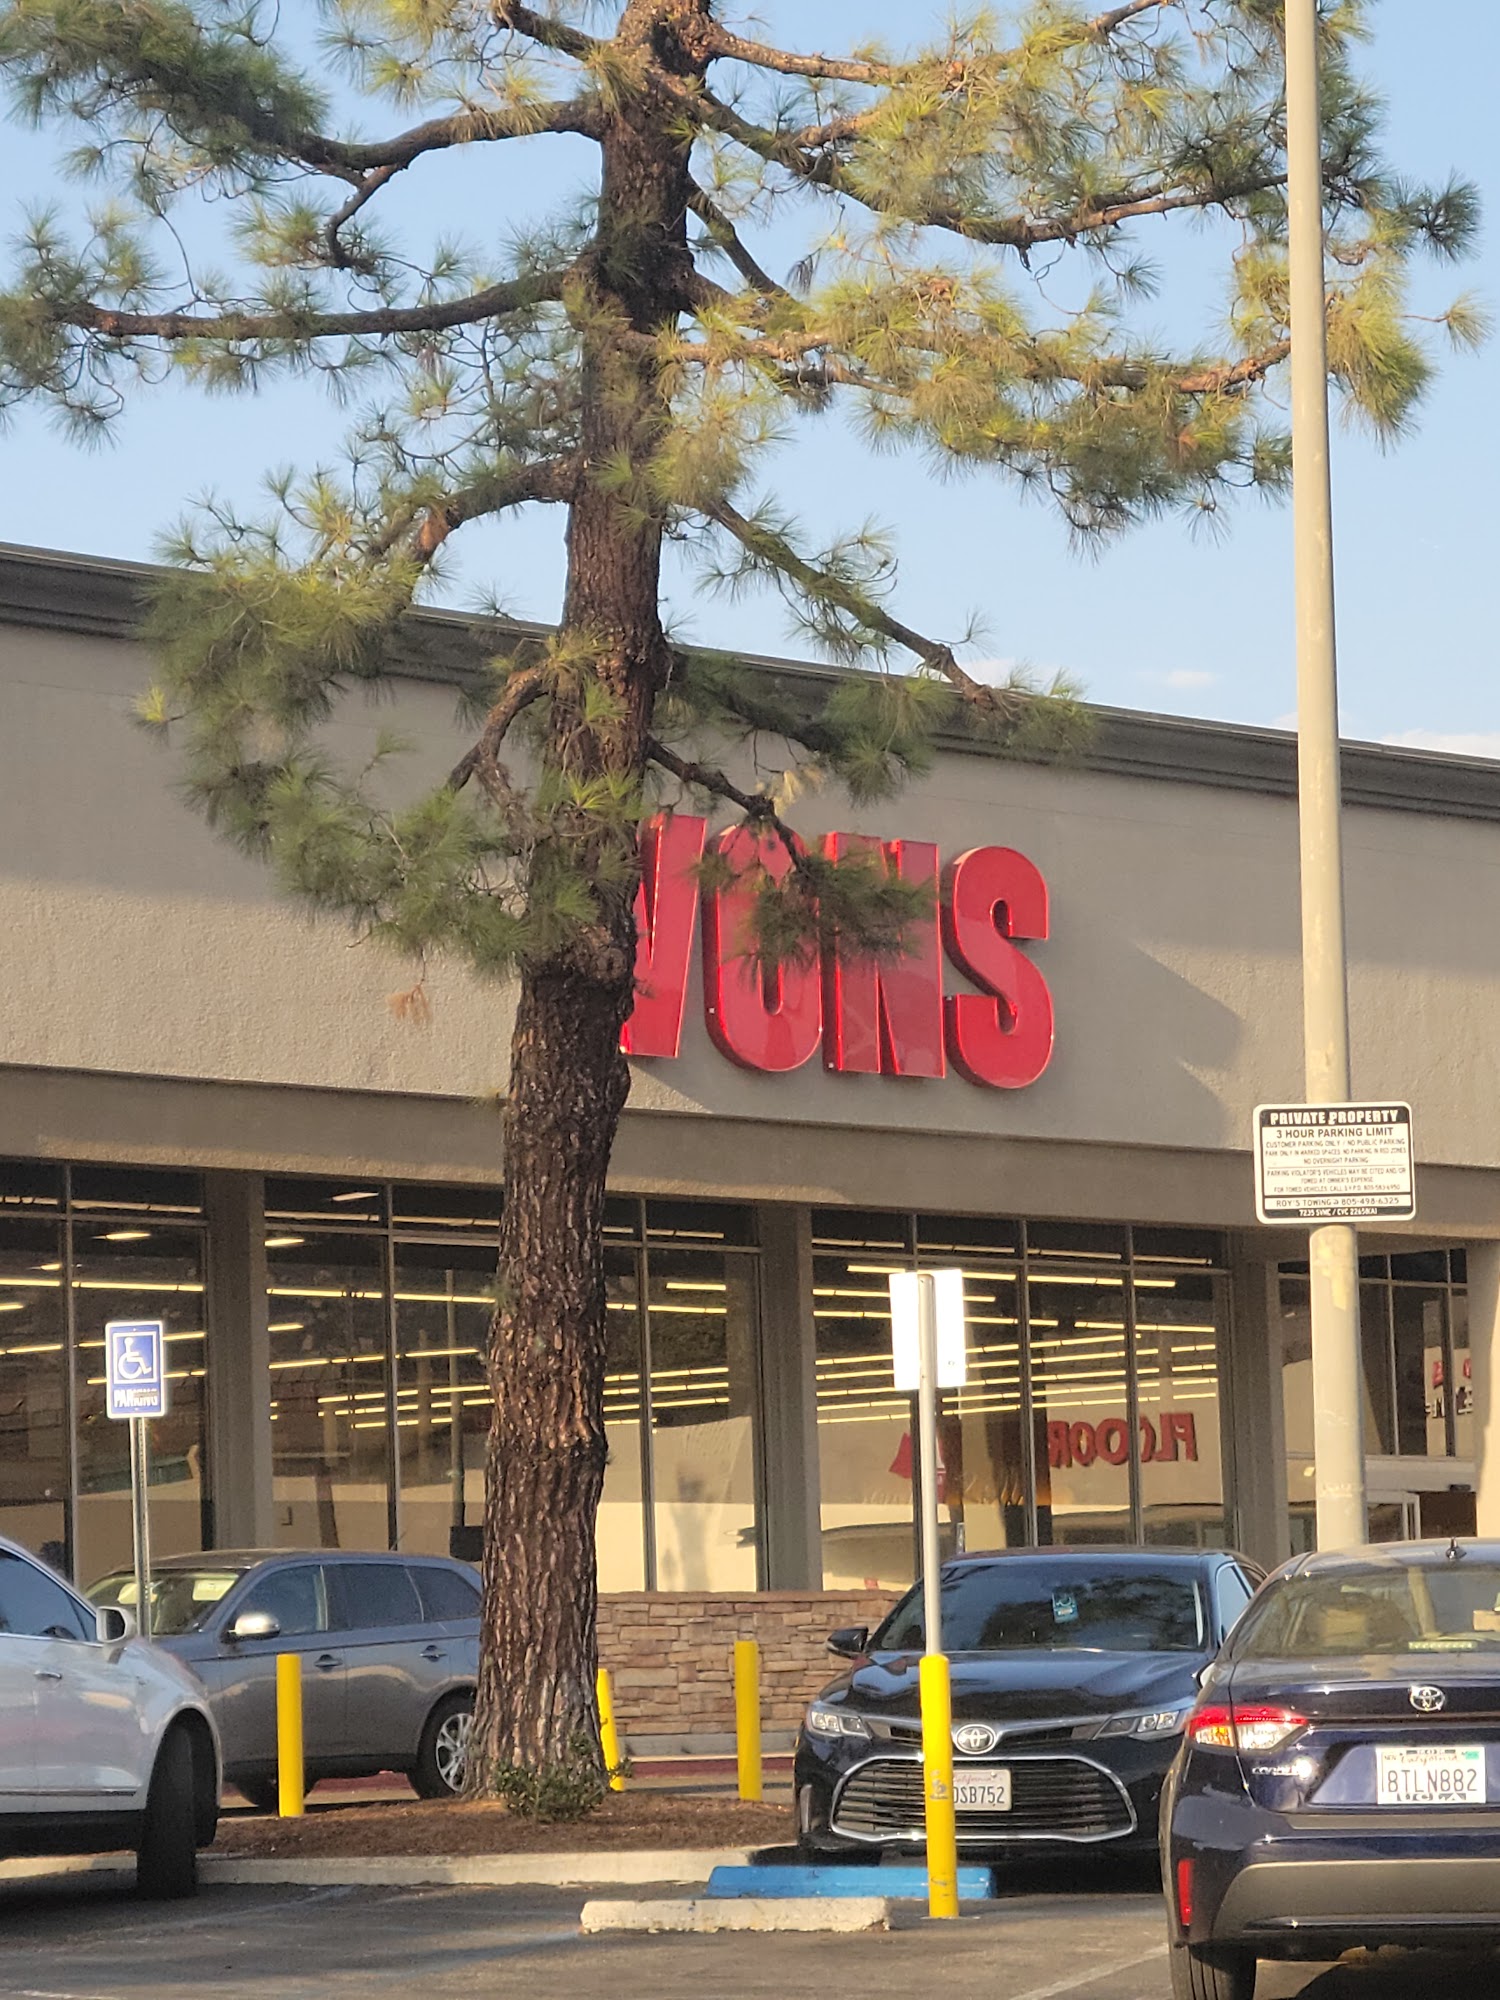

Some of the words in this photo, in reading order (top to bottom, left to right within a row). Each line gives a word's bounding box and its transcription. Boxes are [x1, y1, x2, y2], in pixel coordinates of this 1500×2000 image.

[619, 812, 1055, 1089] VONS
[1270, 1112, 1326, 1125] PRIVATE
[1328, 1110, 1398, 1125] PROPERTY
[1276, 1129, 1282, 1139] 3
[1285, 1129, 1315, 1139] HOUR
[1317, 1127, 1363, 1138] PARKING
[1366, 1127, 1394, 1136] LIMIT
[1356, 1138, 1378, 1146] PUBLIC
[1276, 1199, 1301, 1207] ROY'S
[1303, 1198, 1332, 1207] TOWING
[1341, 1197, 1399, 1206] 805-498-6325
[113, 1388, 158, 1408] PARKING
[1387, 1768, 1478, 1793] 8TLN882
[953, 1785, 1006, 1805] DSB752
